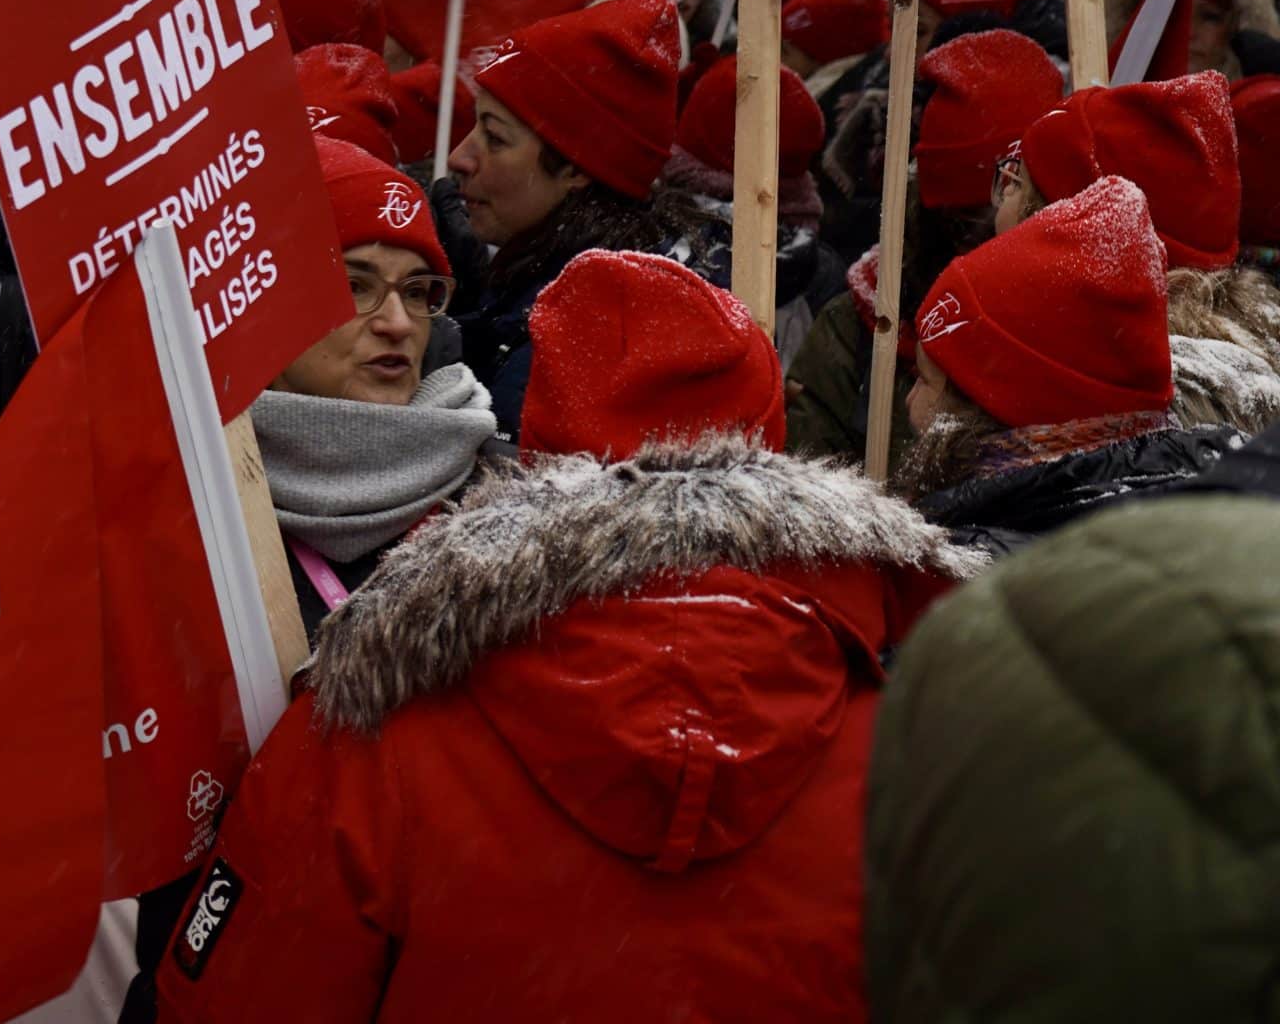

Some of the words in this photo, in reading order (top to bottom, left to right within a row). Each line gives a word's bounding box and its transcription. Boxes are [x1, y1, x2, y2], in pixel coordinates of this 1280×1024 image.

[188, 201, 257, 290] AGÉS
[193, 249, 278, 346] ILISÉS
[101, 706, 160, 759] ne
